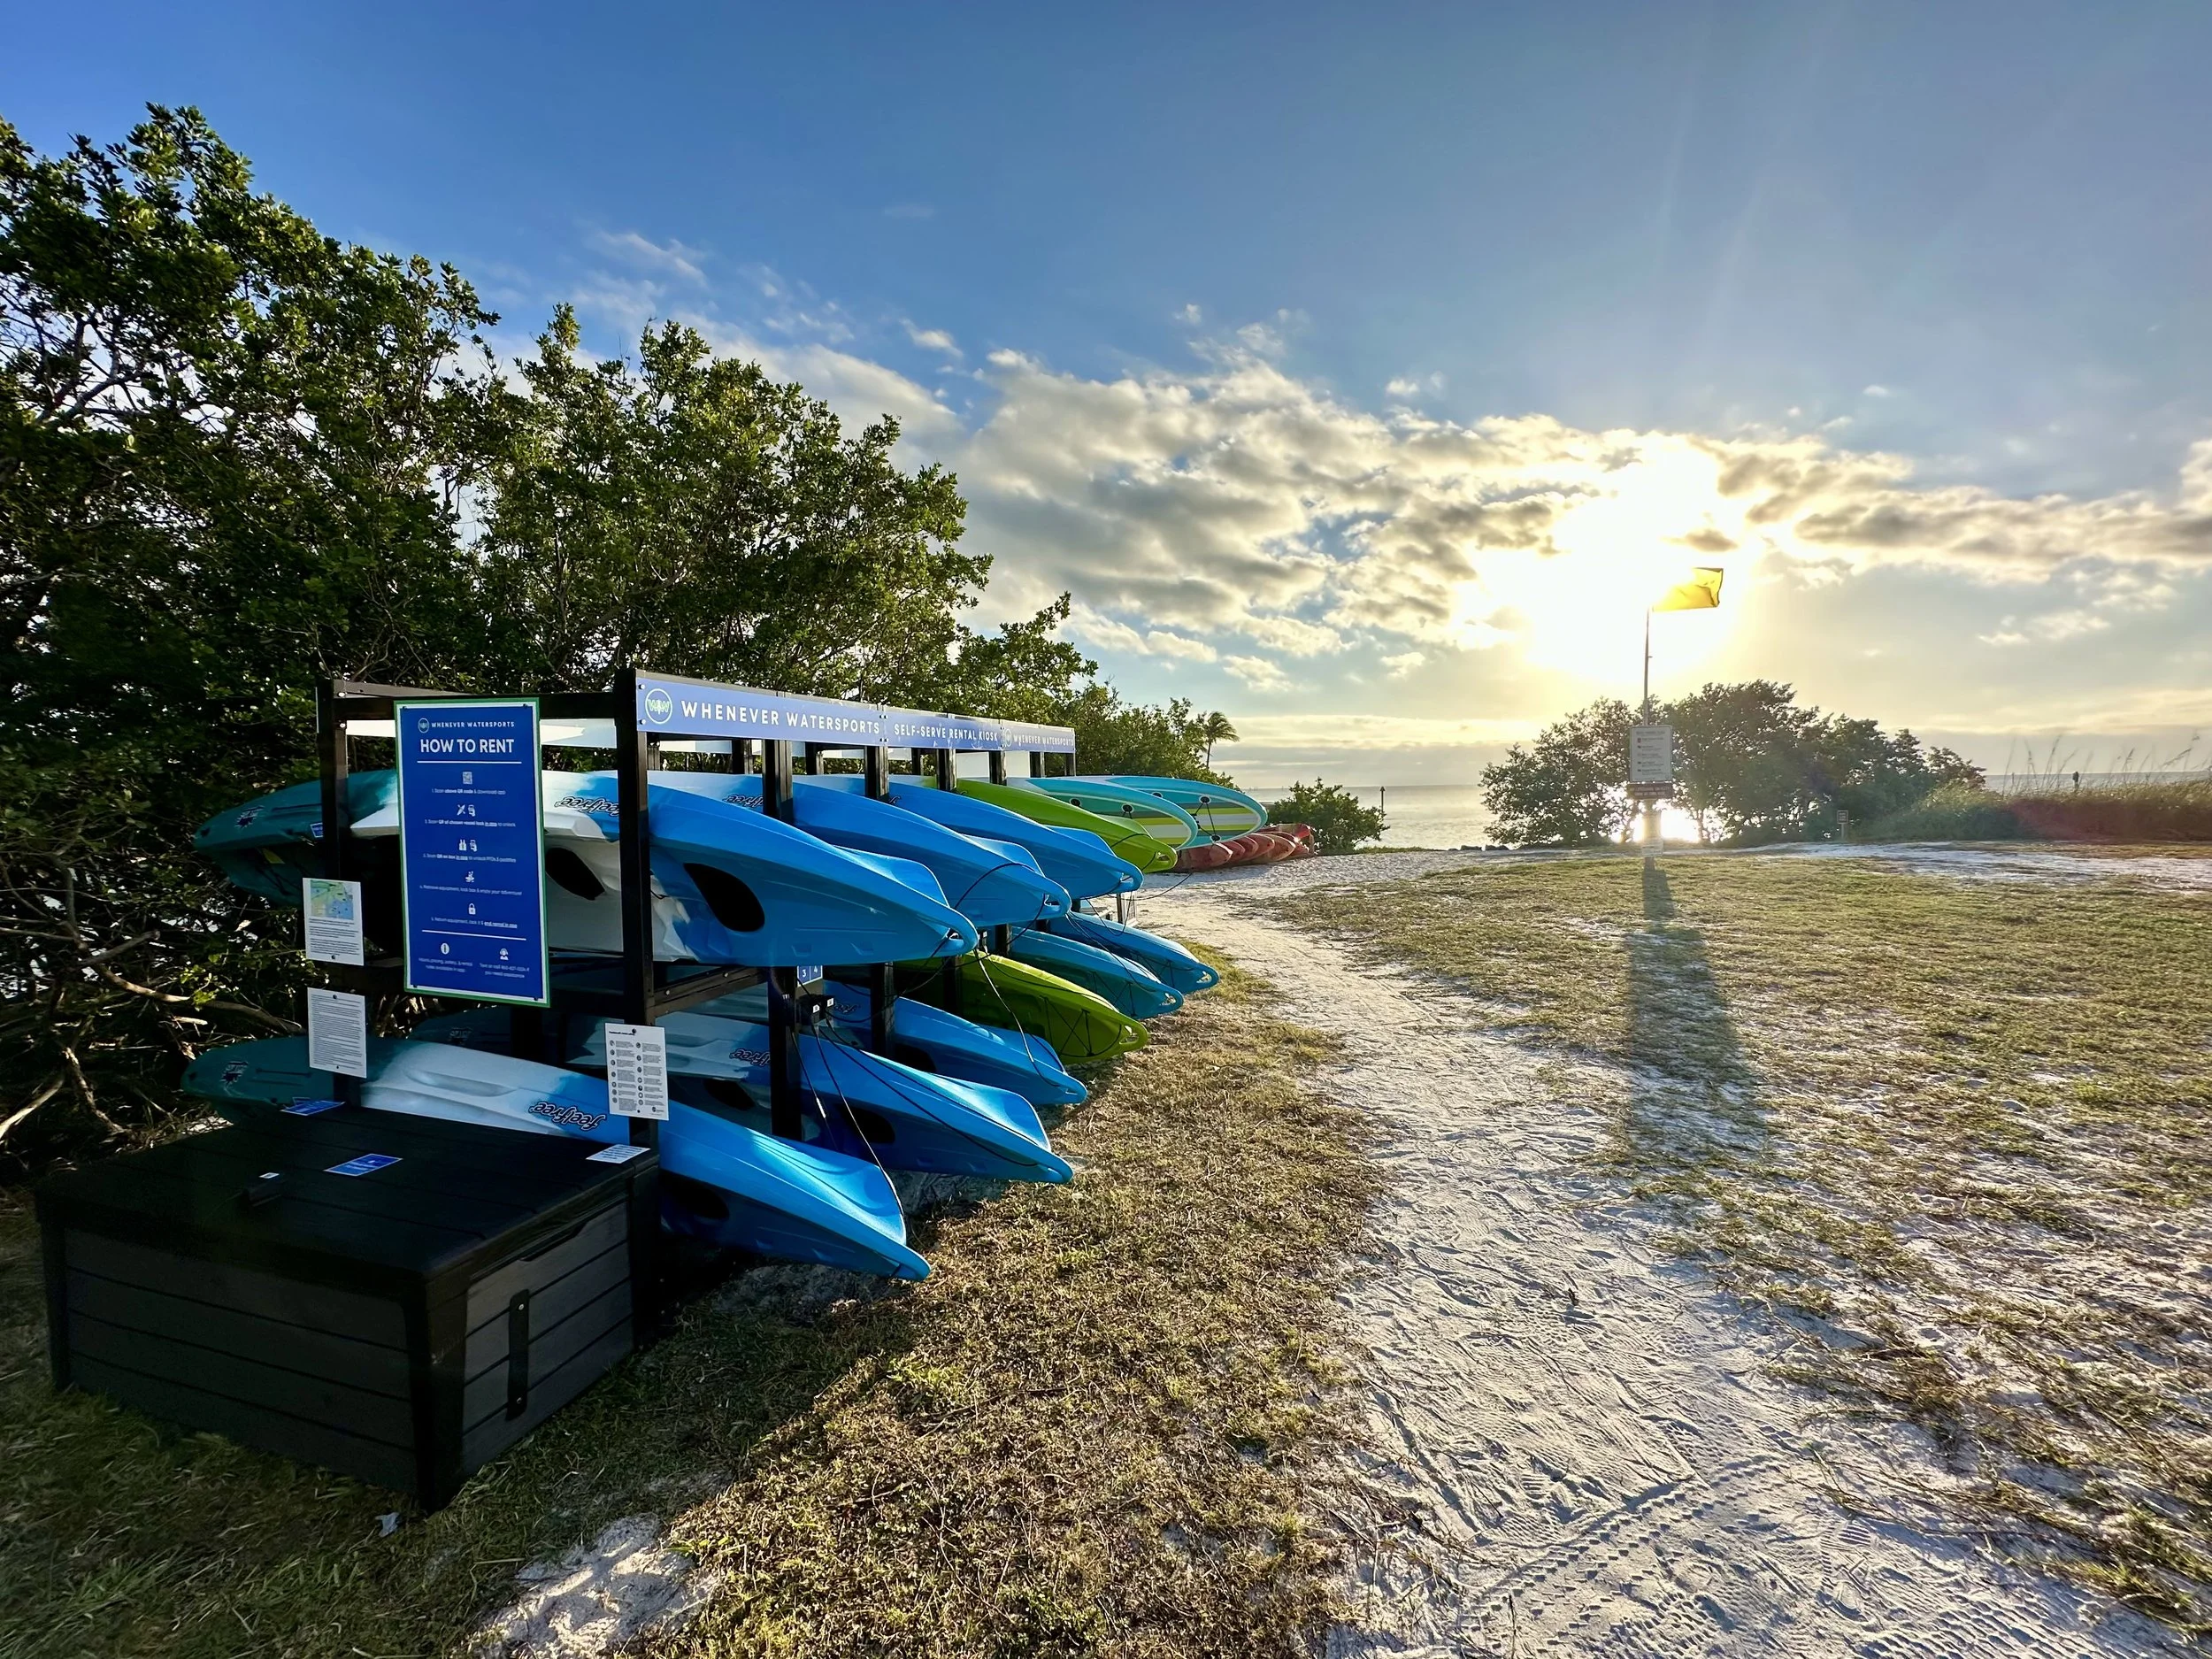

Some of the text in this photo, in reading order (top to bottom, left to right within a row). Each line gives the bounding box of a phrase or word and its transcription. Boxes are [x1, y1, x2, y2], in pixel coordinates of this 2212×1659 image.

[681, 700, 879, 734] WHENEVER WATERSPORTS
[894, 723, 998, 741] SELF-SERVE RENTAL KIOSK
[1013, 733, 1074, 747] WHENEVER WATERSPORTS
[420, 739, 515, 753] HOW TO RENT
[802, 969, 807, 978] 3
[528, 1102, 607, 1131] feelfree
